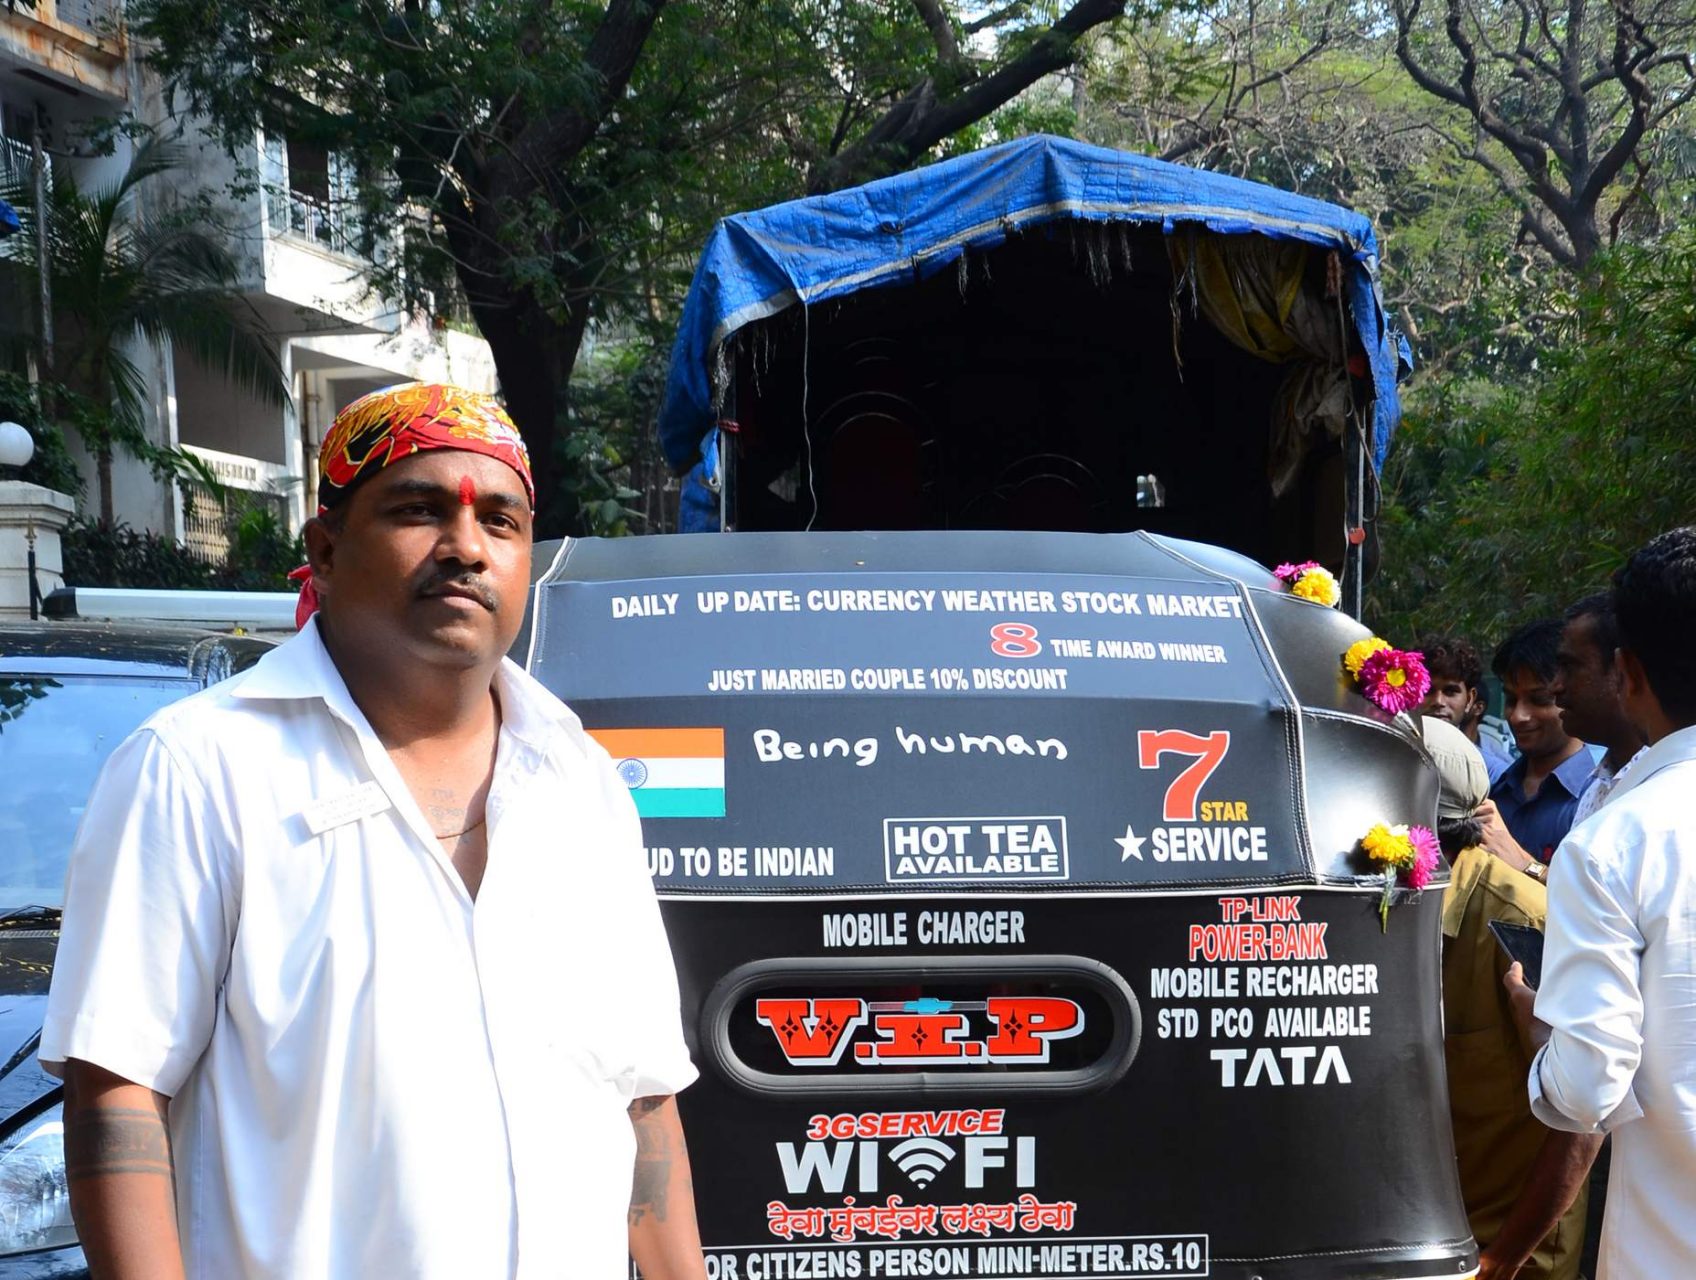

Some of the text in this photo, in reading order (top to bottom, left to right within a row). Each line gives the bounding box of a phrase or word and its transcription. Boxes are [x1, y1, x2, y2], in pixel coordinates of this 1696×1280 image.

[612, 590, 1242, 618] DAILY UP DATE: CURRENCY WEATHER STOCK MARKET
[990, 622, 1227, 664] 8 TIME AWARD WINNER
[708, 669, 1068, 691] JUST MARRIED COUPLE 10% DISCOUNT
[753, 726, 1068, 767] Being human
[1137, 729, 1230, 822] 7
[1200, 801, 1249, 822] STAR
[894, 825, 1057, 856] HOT TEA
[1151, 826, 1268, 862] SERVICE
[643, 847, 834, 877] UD TO BE INDIAN
[896, 854, 1059, 875] AVAILABLE
[823, 911, 1025, 947] MOBILE CHARGER
[1151, 964, 1379, 998] MOBILE RECHARGER
[1157, 1006, 1371, 1038] STD PCO AVAILABLE
[1210, 1045, 1351, 1087] TATA
[767, 1193, 1077, 1242] देवा मुंबईवर लक्ष्य ठेवा
[869, 1247, 969, 1276] PERSON
